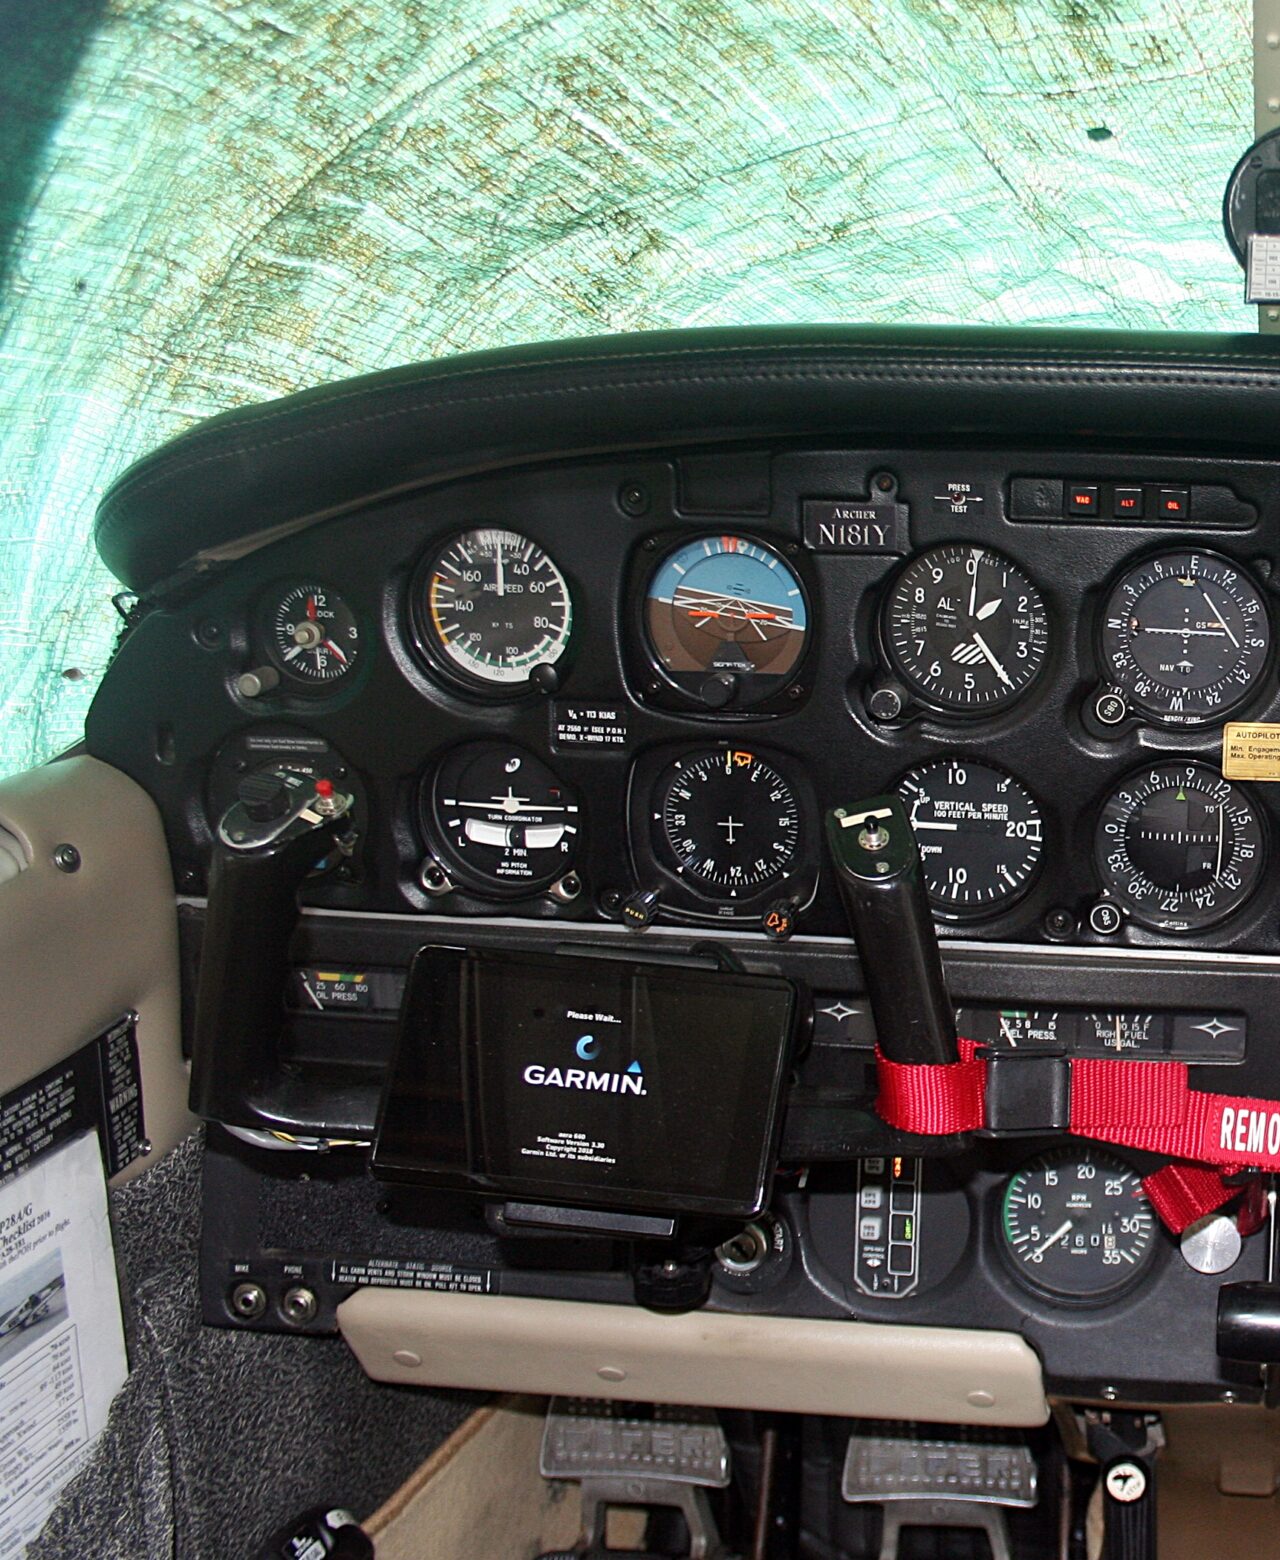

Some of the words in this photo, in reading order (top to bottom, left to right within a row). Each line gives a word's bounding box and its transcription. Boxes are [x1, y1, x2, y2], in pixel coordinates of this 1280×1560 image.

[948, 483, 971, 492] PRESS
[1121, 499, 1134, 507] ALT
[950, 505, 968, 513] TEST
[818, 523, 891, 546] N181Y
[513, 564, 529, 576] 40
[462, 571, 482, 582] 160
[1222, 569, 1238, 585] 12
[530, 582, 546, 594] 60
[314, 594, 327, 607] 12
[455, 601, 474, 612] 140
[534, 617, 548, 629] 80
[1160, 664, 1175, 672] NAV
[1236, 732, 1280, 740] AUTOPILOT
[1248, 753, 1280, 762] Operating
[948, 768, 967, 785] 10
[996, 784, 1008, 793] 15
[920, 796, 931, 804] UP
[934, 800, 976, 812] VERTICAL
[982, 803, 1009, 813] SPEED
[504, 814, 543, 823] COORDINATOR
[948, 811, 966, 819] FEET
[984, 812, 1009, 821] MINUTE
[1005, 821, 1027, 838] 20
[458, 836, 466, 847] L
[560, 842, 569, 853] R
[922, 846, 943, 854] DOWN
[496, 868, 533, 877] INFORMATION
[996, 864, 1007, 874] 15
[949, 868, 967, 884] 10
[334, 982, 346, 991] 60
[356, 984, 369, 993] 100
[316, 992, 329, 1000] OIL
[332, 992, 358, 1002] PRESS
[567, 1010, 594, 1022] Please
[1048, 1022, 1056, 1030] 15
[1028, 1030, 1057, 1040] PRESS.
[1124, 1032, 1149, 1040] FUEL
[537, 1136, 565, 1145] Software
[566, 1138, 590, 1147] Version
[546, 1144, 577, 1154] Copyright
[521, 1148, 544, 1156] Garmin
[578, 1154, 616, 1164] subsidiaries
[1077, 1164, 1096, 1179] 20
[1045, 1170, 1059, 1186] 15
[1105, 1180, 1123, 1196] 25
[1027, 1194, 1042, 1209] 10
[1120, 1218, 1140, 1234] 30
[234, 1265, 249, 1273] MIKE
[368, 1259, 399, 1269] ALTERNATE
[284, 1266, 303, 1275] PHONE
